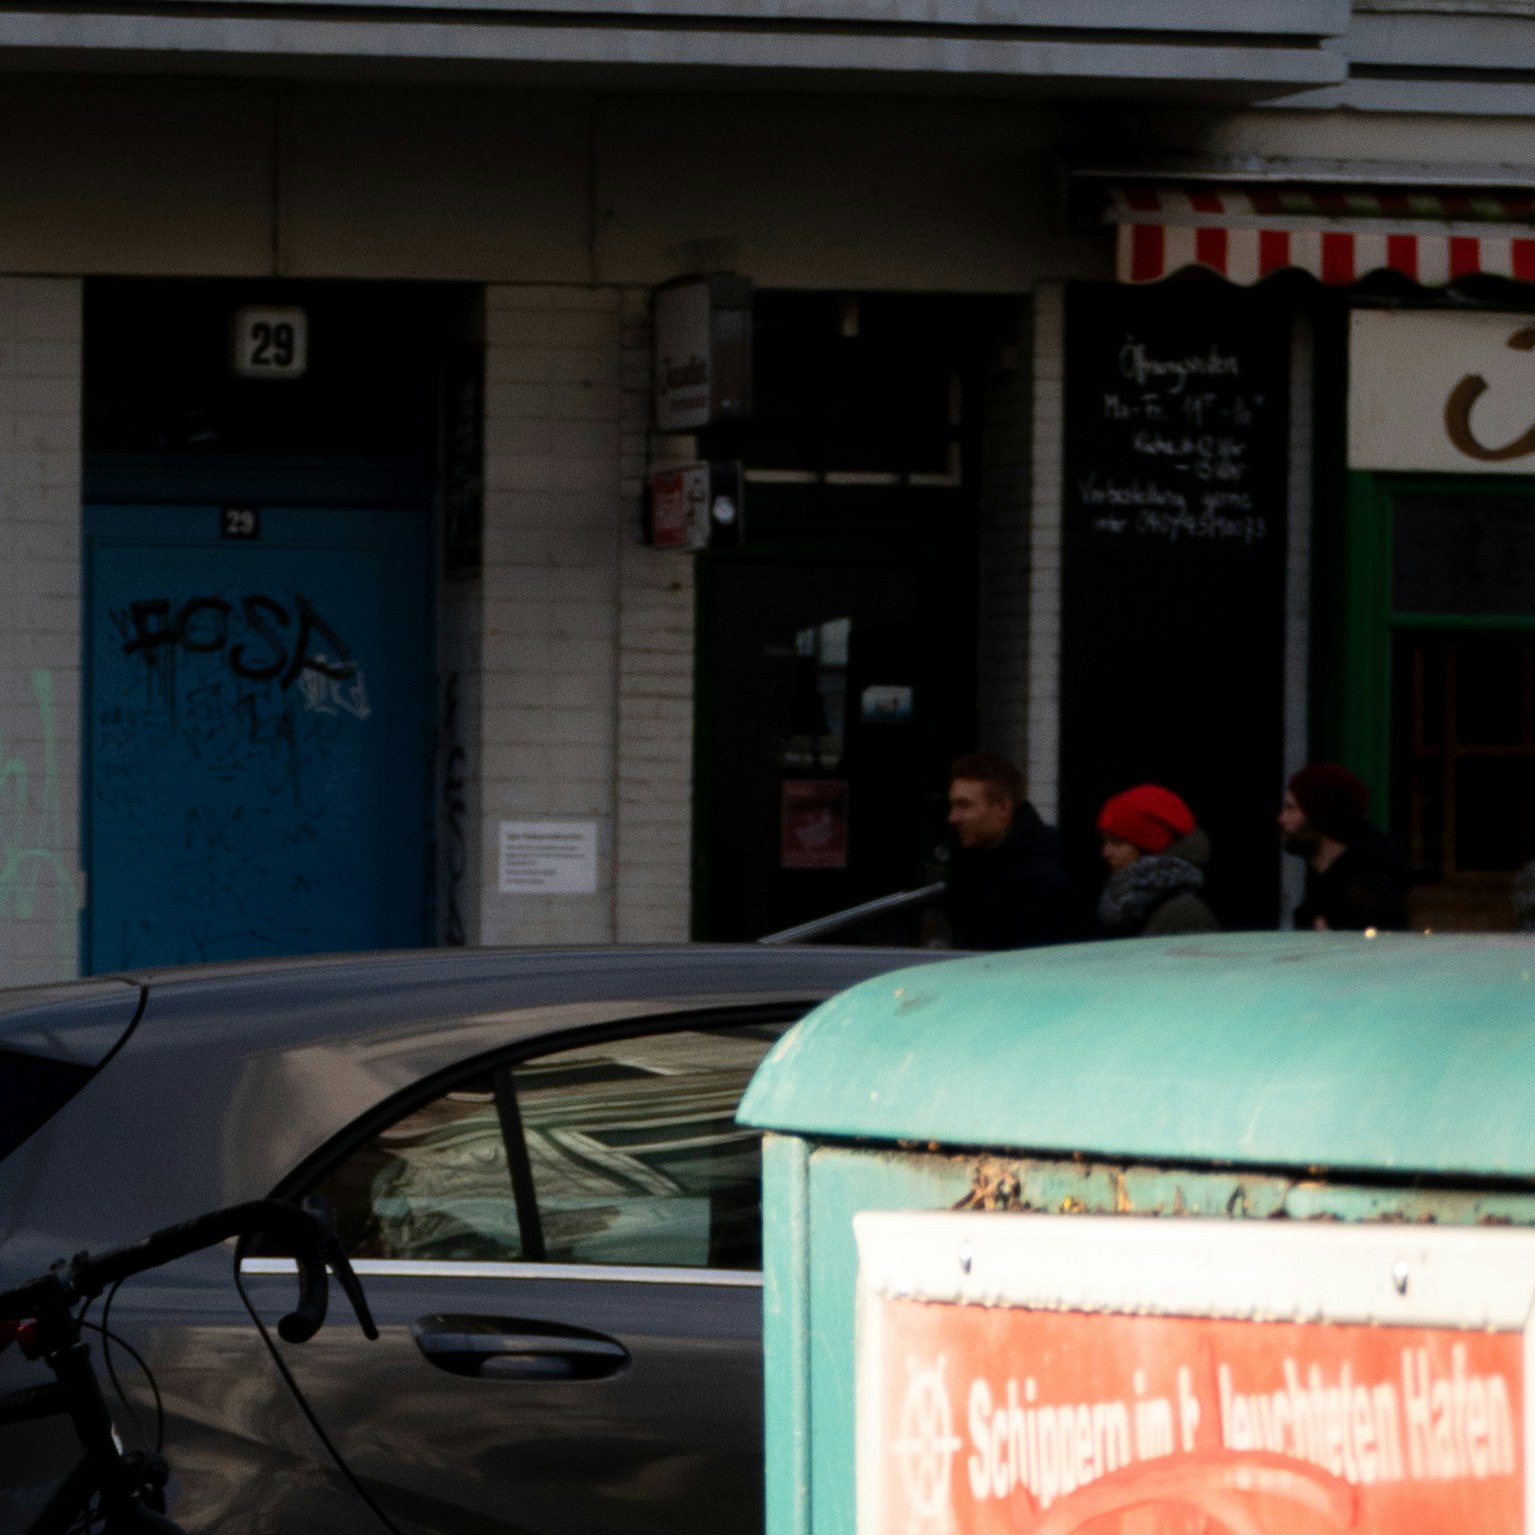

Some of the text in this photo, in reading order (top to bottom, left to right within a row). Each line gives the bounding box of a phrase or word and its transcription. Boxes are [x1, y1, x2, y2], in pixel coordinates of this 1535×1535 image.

[249, 321, 294, 368] 29
[223, 510, 257, 536] 29
[967, 1343, 1515, 1509] Schippern im bleuchteten Hafen
